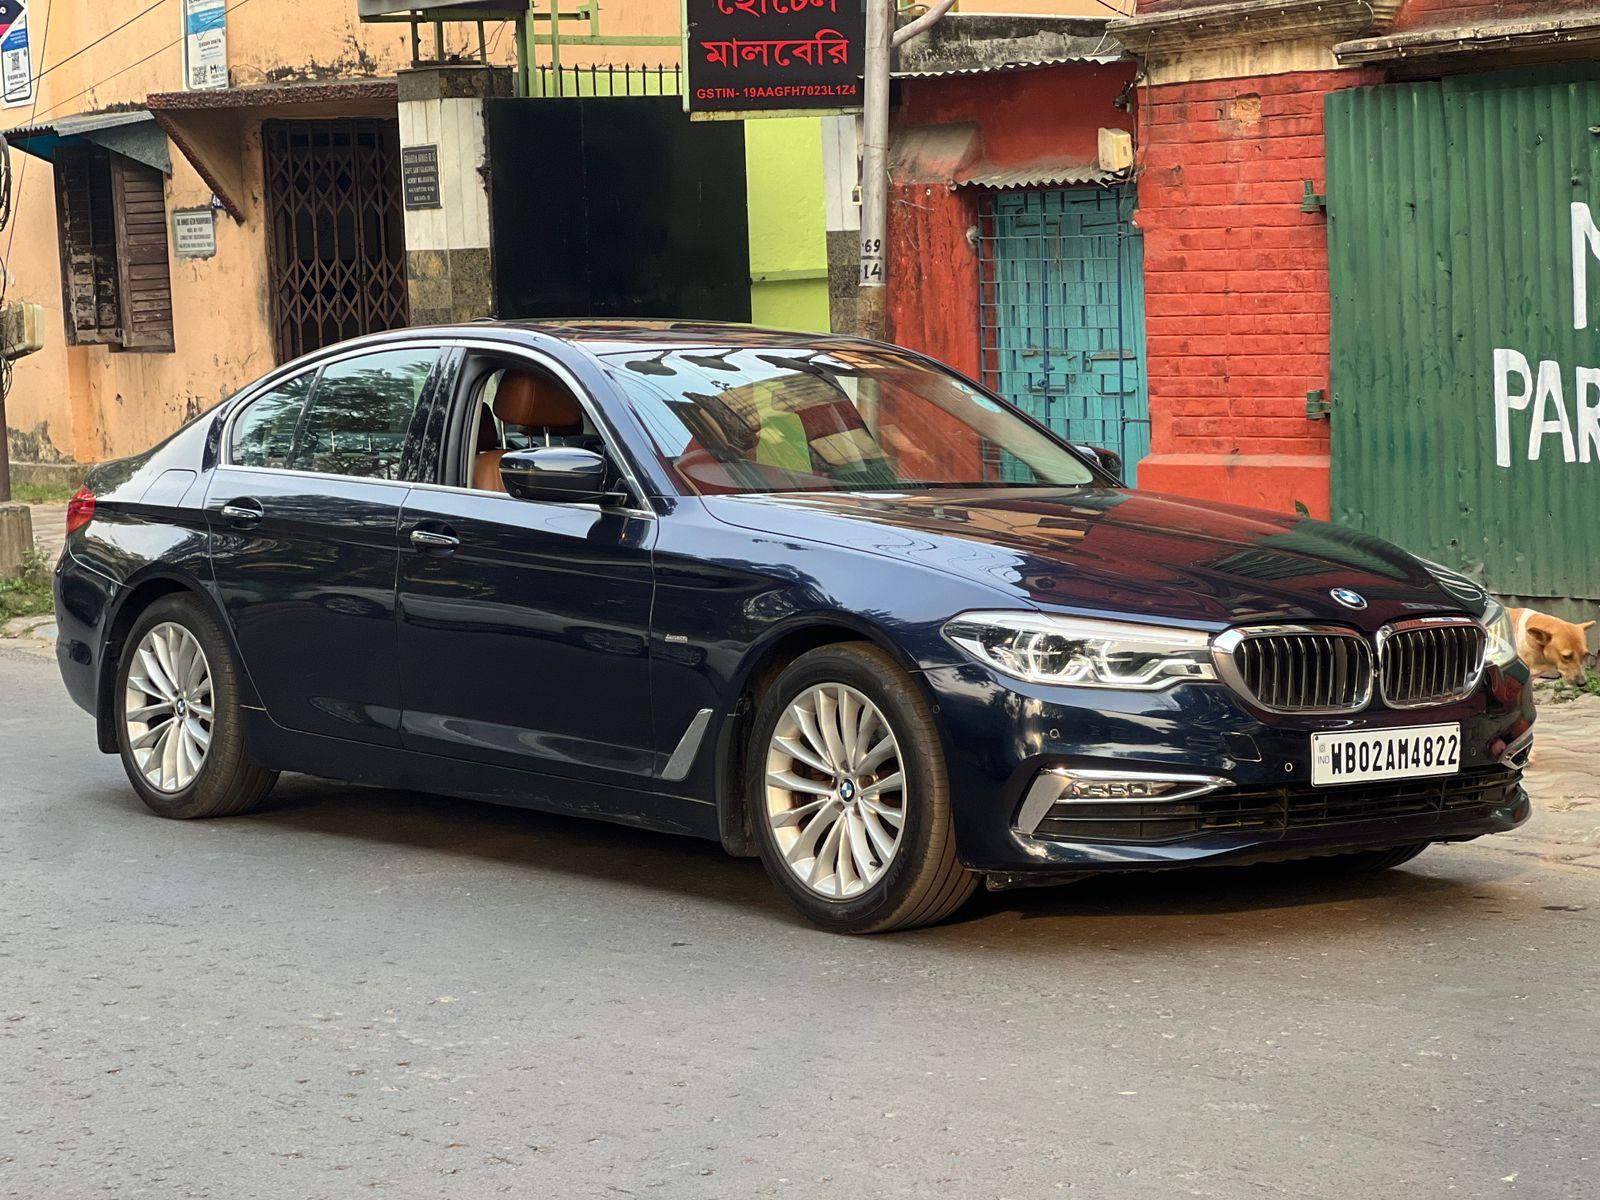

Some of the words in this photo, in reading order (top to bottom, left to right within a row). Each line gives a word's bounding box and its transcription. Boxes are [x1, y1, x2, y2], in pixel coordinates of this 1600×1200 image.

[701, 29, 849, 68] মালবেরি
[697, 88, 739, 99] GSTIN-
[743, 85, 857, 97] 19AAGFH7023L1Z4
[865, 239, 881, 252] 69
[864, 263, 882, 281] 14
[1318, 755, 1330, 765] IND
[1331, 735, 1458, 774] WB02AM4822
